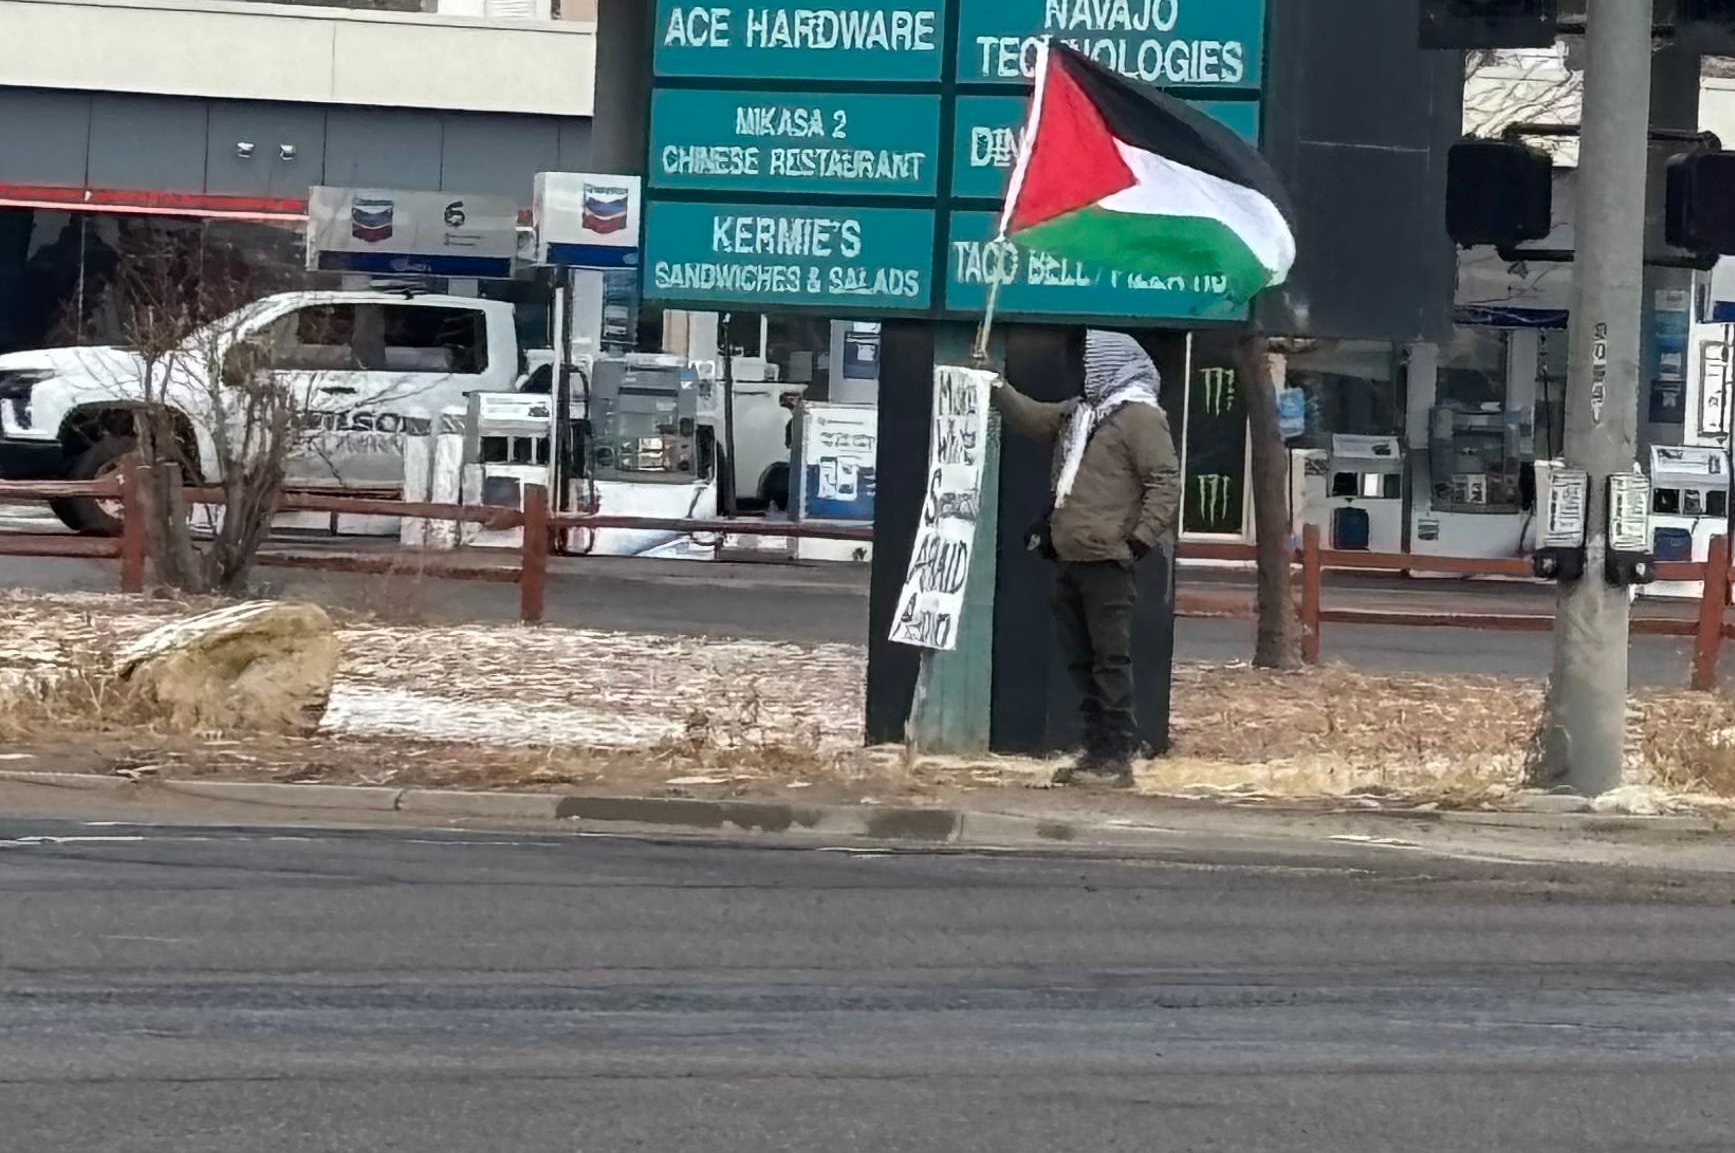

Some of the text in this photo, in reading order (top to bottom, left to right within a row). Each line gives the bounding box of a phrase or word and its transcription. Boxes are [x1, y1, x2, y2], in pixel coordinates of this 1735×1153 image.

[665, 7, 934, 50] ACE HARDWARE
[976, 36, 1244, 83] TECOLOGIES
[736, 107, 846, 138] MIKASA 2
[663, 146, 925, 179] CHINESE RESTAURANT
[444, 200, 465, 228] 6
[714, 217, 860, 257] KERMIE'S
[656, 262, 918, 296] SANDWICHES & SALADS
[953, 241, 1018, 285] TACO
